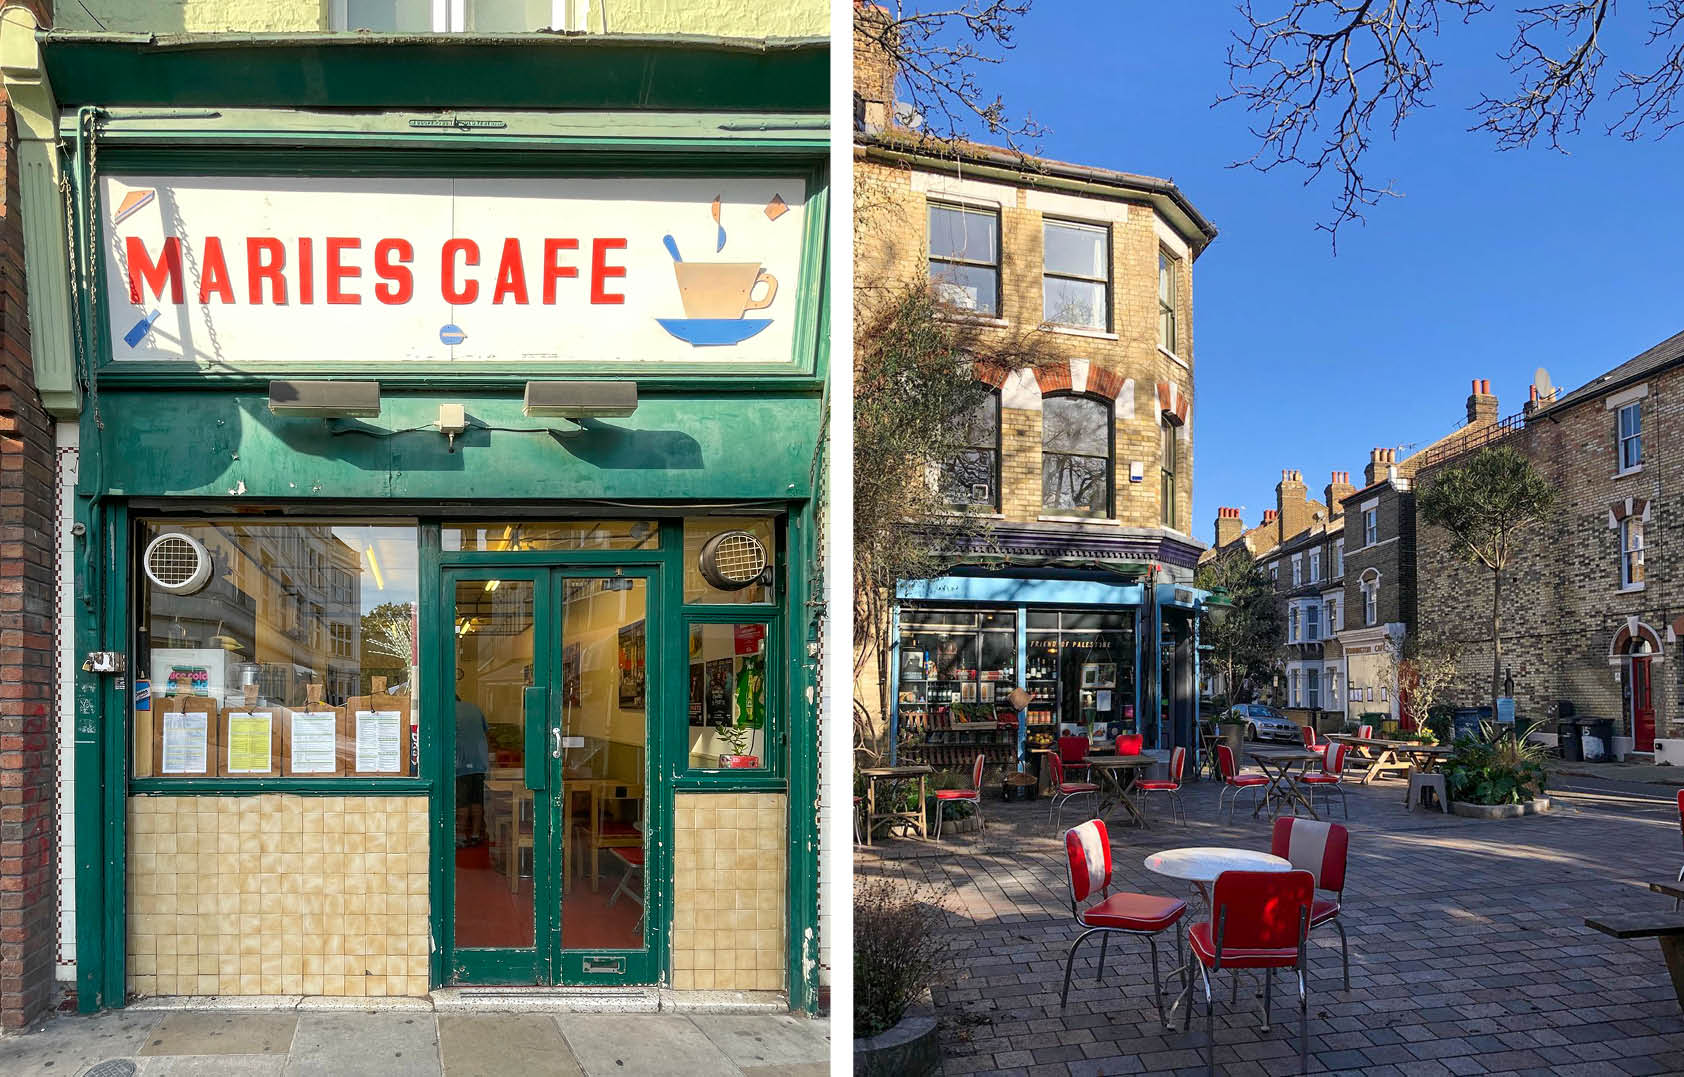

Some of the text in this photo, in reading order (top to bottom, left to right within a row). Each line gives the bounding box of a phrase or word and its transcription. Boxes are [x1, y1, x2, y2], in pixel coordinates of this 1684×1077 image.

[126, 237, 626, 304] MARIES CAFE
[187, 671, 208, 680] cold
